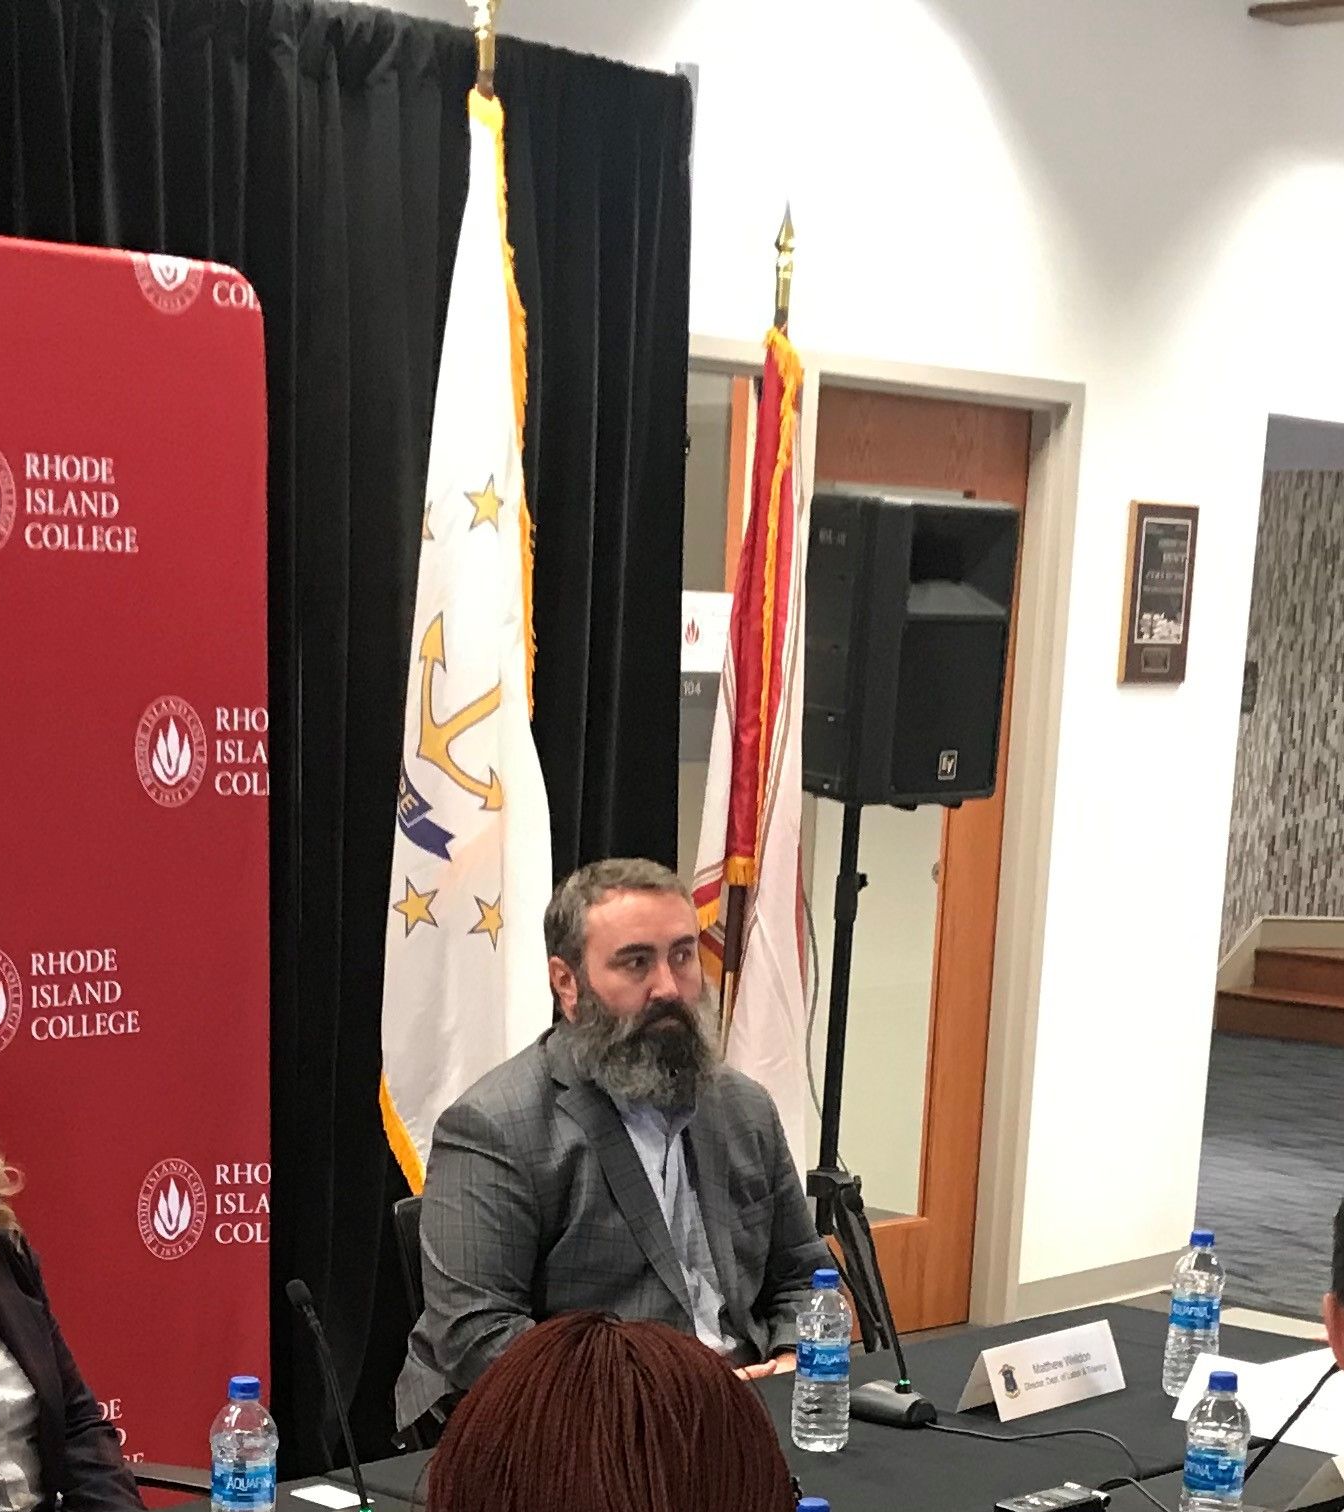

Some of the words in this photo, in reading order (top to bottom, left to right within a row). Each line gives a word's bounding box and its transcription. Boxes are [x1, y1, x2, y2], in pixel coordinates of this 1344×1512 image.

[24, 452, 116, 484] RHODE
[25, 487, 120, 519] ISLAND
[24, 521, 140, 553] COLLEGE
[215, 706, 270, 733] RHO
[215, 739, 269, 765] ISLA
[31, 948, 118, 976] RHODE
[31, 979, 122, 1009] ISLAND
[31, 1010, 141, 1041] COLLEGE
[146, 1160, 189, 1188] ISLAND
[215, 1162, 271, 1186] RHO
[215, 1192, 270, 1215] ISLA
